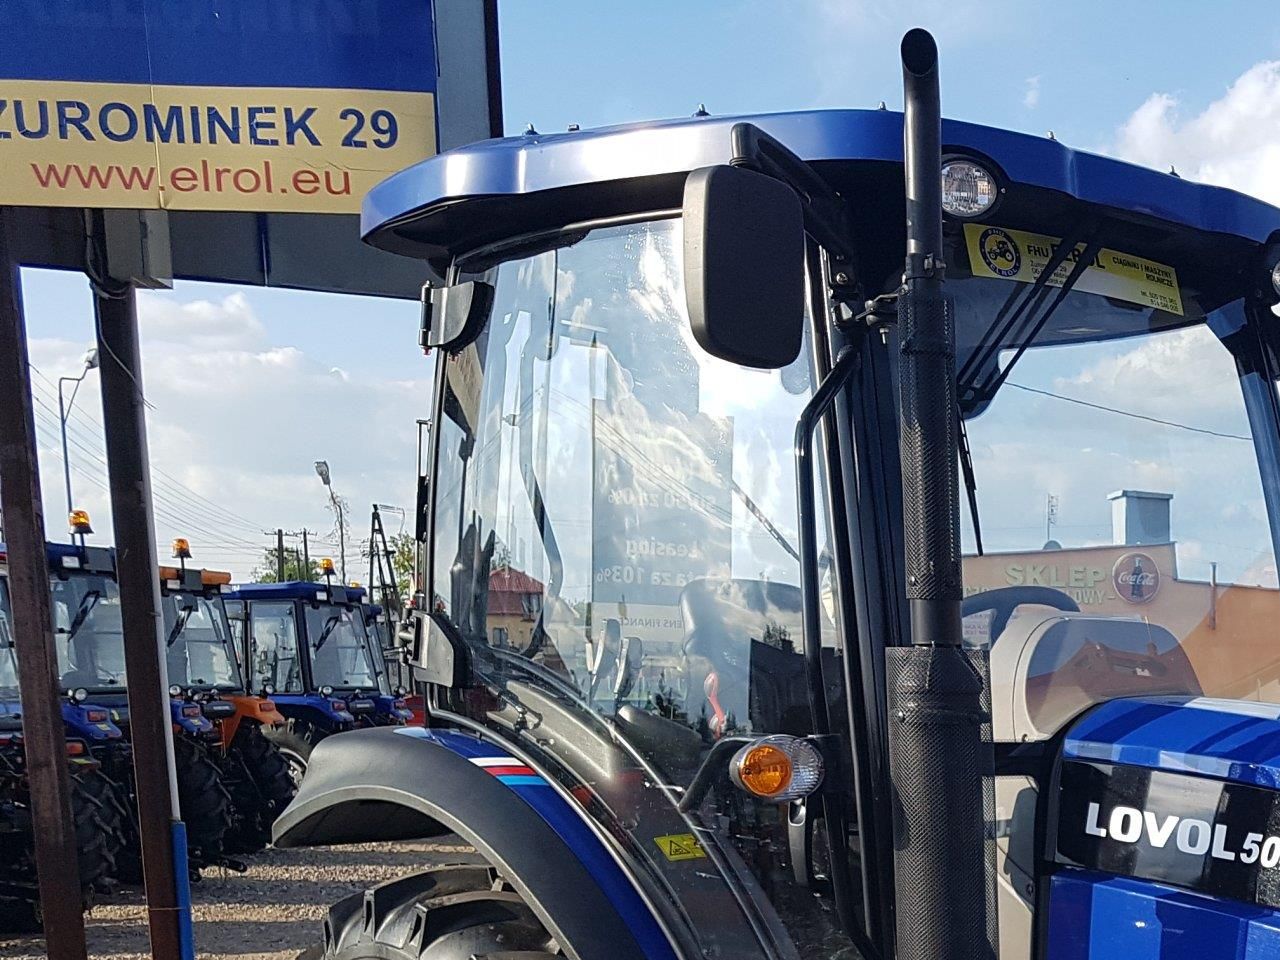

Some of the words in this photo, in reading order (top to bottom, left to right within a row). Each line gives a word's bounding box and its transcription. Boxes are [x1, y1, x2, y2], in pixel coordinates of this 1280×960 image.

[339, 108, 399, 149] 29
[31, 159, 351, 195] www.elrol.eu
[1027, 245, 1049, 257] FHU
[1004, 565, 1107, 589] SKLEP
[1085, 802, 1235, 861] LOVOL
